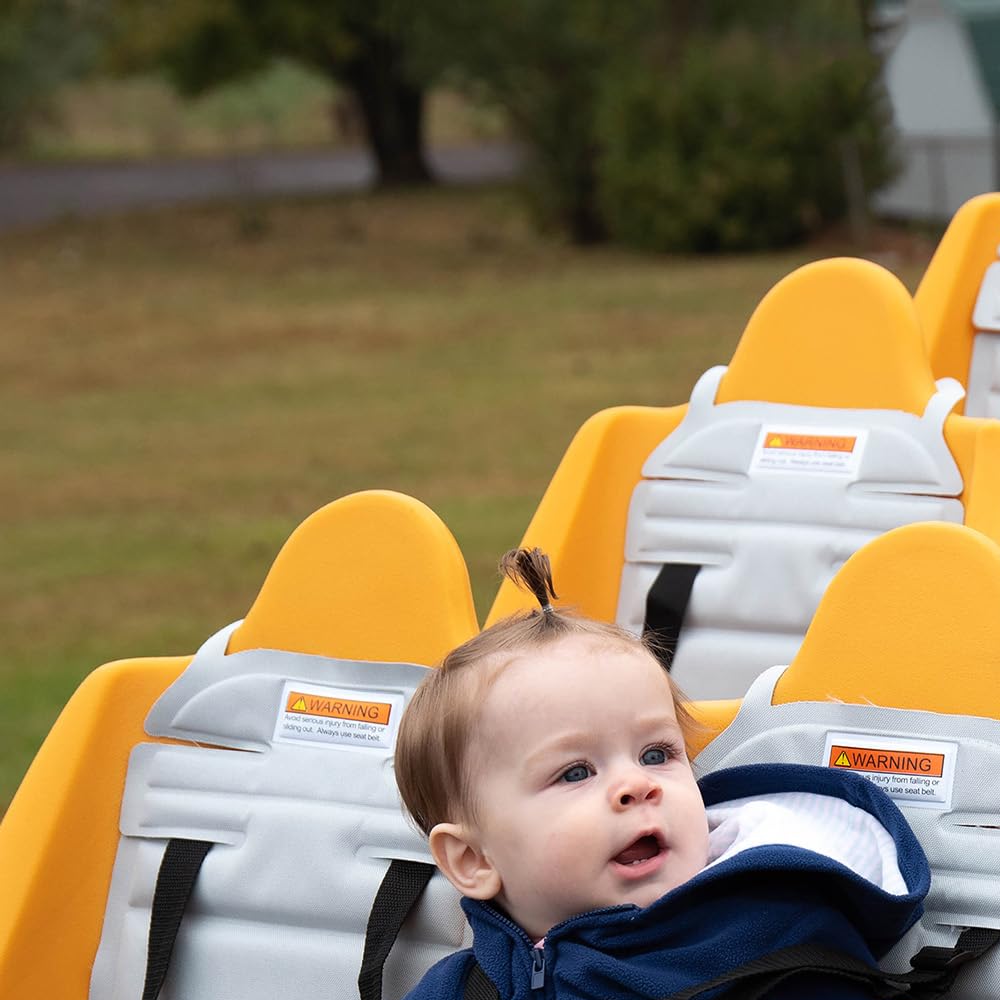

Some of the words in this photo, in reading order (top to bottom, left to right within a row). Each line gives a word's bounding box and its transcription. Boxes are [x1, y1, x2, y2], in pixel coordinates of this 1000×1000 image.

[309, 699, 379, 719] WARNING
[284, 713, 302, 722] Avoid
[302, 716, 324, 725] serious
[325, 718, 342, 728] injury
[342, 720, 360, 728] from
[359, 722, 377, 733] falling
[316, 726, 339, 737] Always
[340, 730, 352, 738] use
[353, 732, 367, 740] seat
[852, 752, 932, 772] WARNING
[871, 774, 890, 784] injury
[891, 775, 909, 784] from
[909, 776, 930, 786] falling
[904, 787, 920, 795] seat
